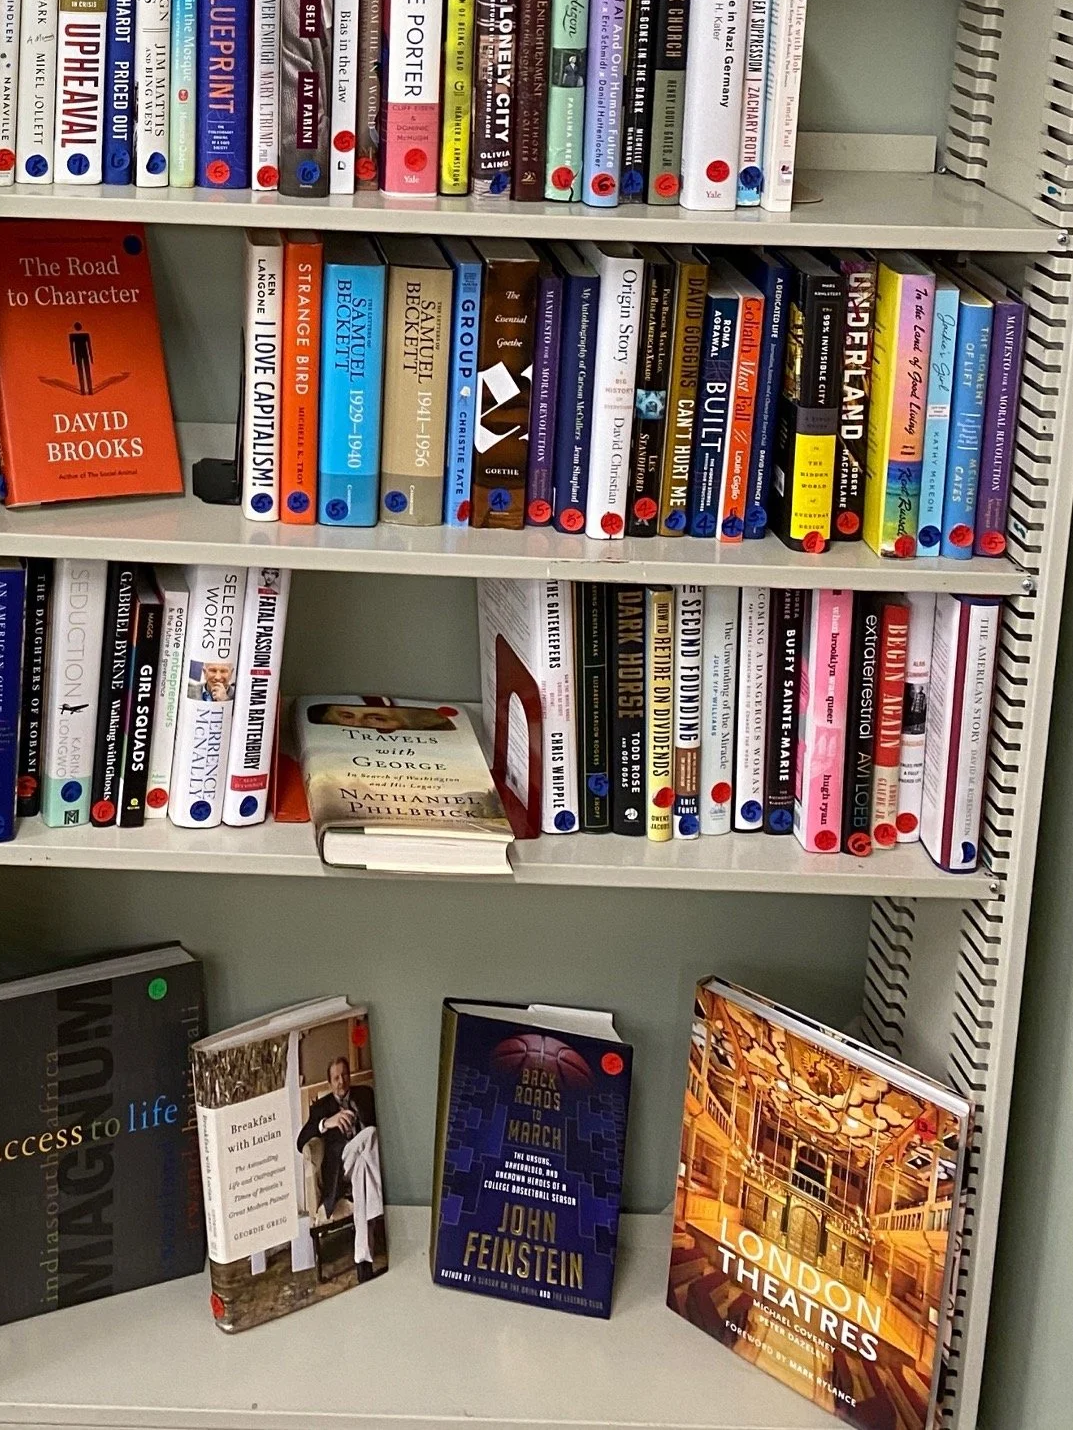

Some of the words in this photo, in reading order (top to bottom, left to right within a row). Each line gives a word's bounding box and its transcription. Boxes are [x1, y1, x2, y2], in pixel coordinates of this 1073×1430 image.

[404, 14, 425, 97] PORTER
[62, 23, 101, 148] UPHEAVAL
[20, 257, 62, 278] The
[66, 256, 120, 276] Road
[7, 287, 28, 306] to
[34, 285, 140, 306] Character
[614, 268, 639, 318] Origin
[252, 333, 276, 374] LOVE
[613, 322, 638, 365] Story
[839, 272, 874, 441] UNDERLAND
[52, 410, 129, 434] DAVID
[250, 376, 275, 488] CAPITALISM!
[700, 381, 727, 453] BUILT
[47, 438, 144, 462] BROOKS
[857, 615, 878, 739] extraterrestrial
[342, 728, 439, 745] TRAVELS
[375, 746, 416, 757] with
[352, 756, 448, 771] GEORGE
[340, 788, 482, 805] NATHANIEL
[347, 802, 479, 819] PHILBRICK
[91, 1117, 121, 1141] to
[128, 1095, 178, 1134] life
[496, 1204, 558, 1242] JOHN
[462, 1232, 584, 1290] FEINSTEIN
[718, 1216, 883, 1334] LONDON
[717, 1246, 879, 1362] THEATRES
